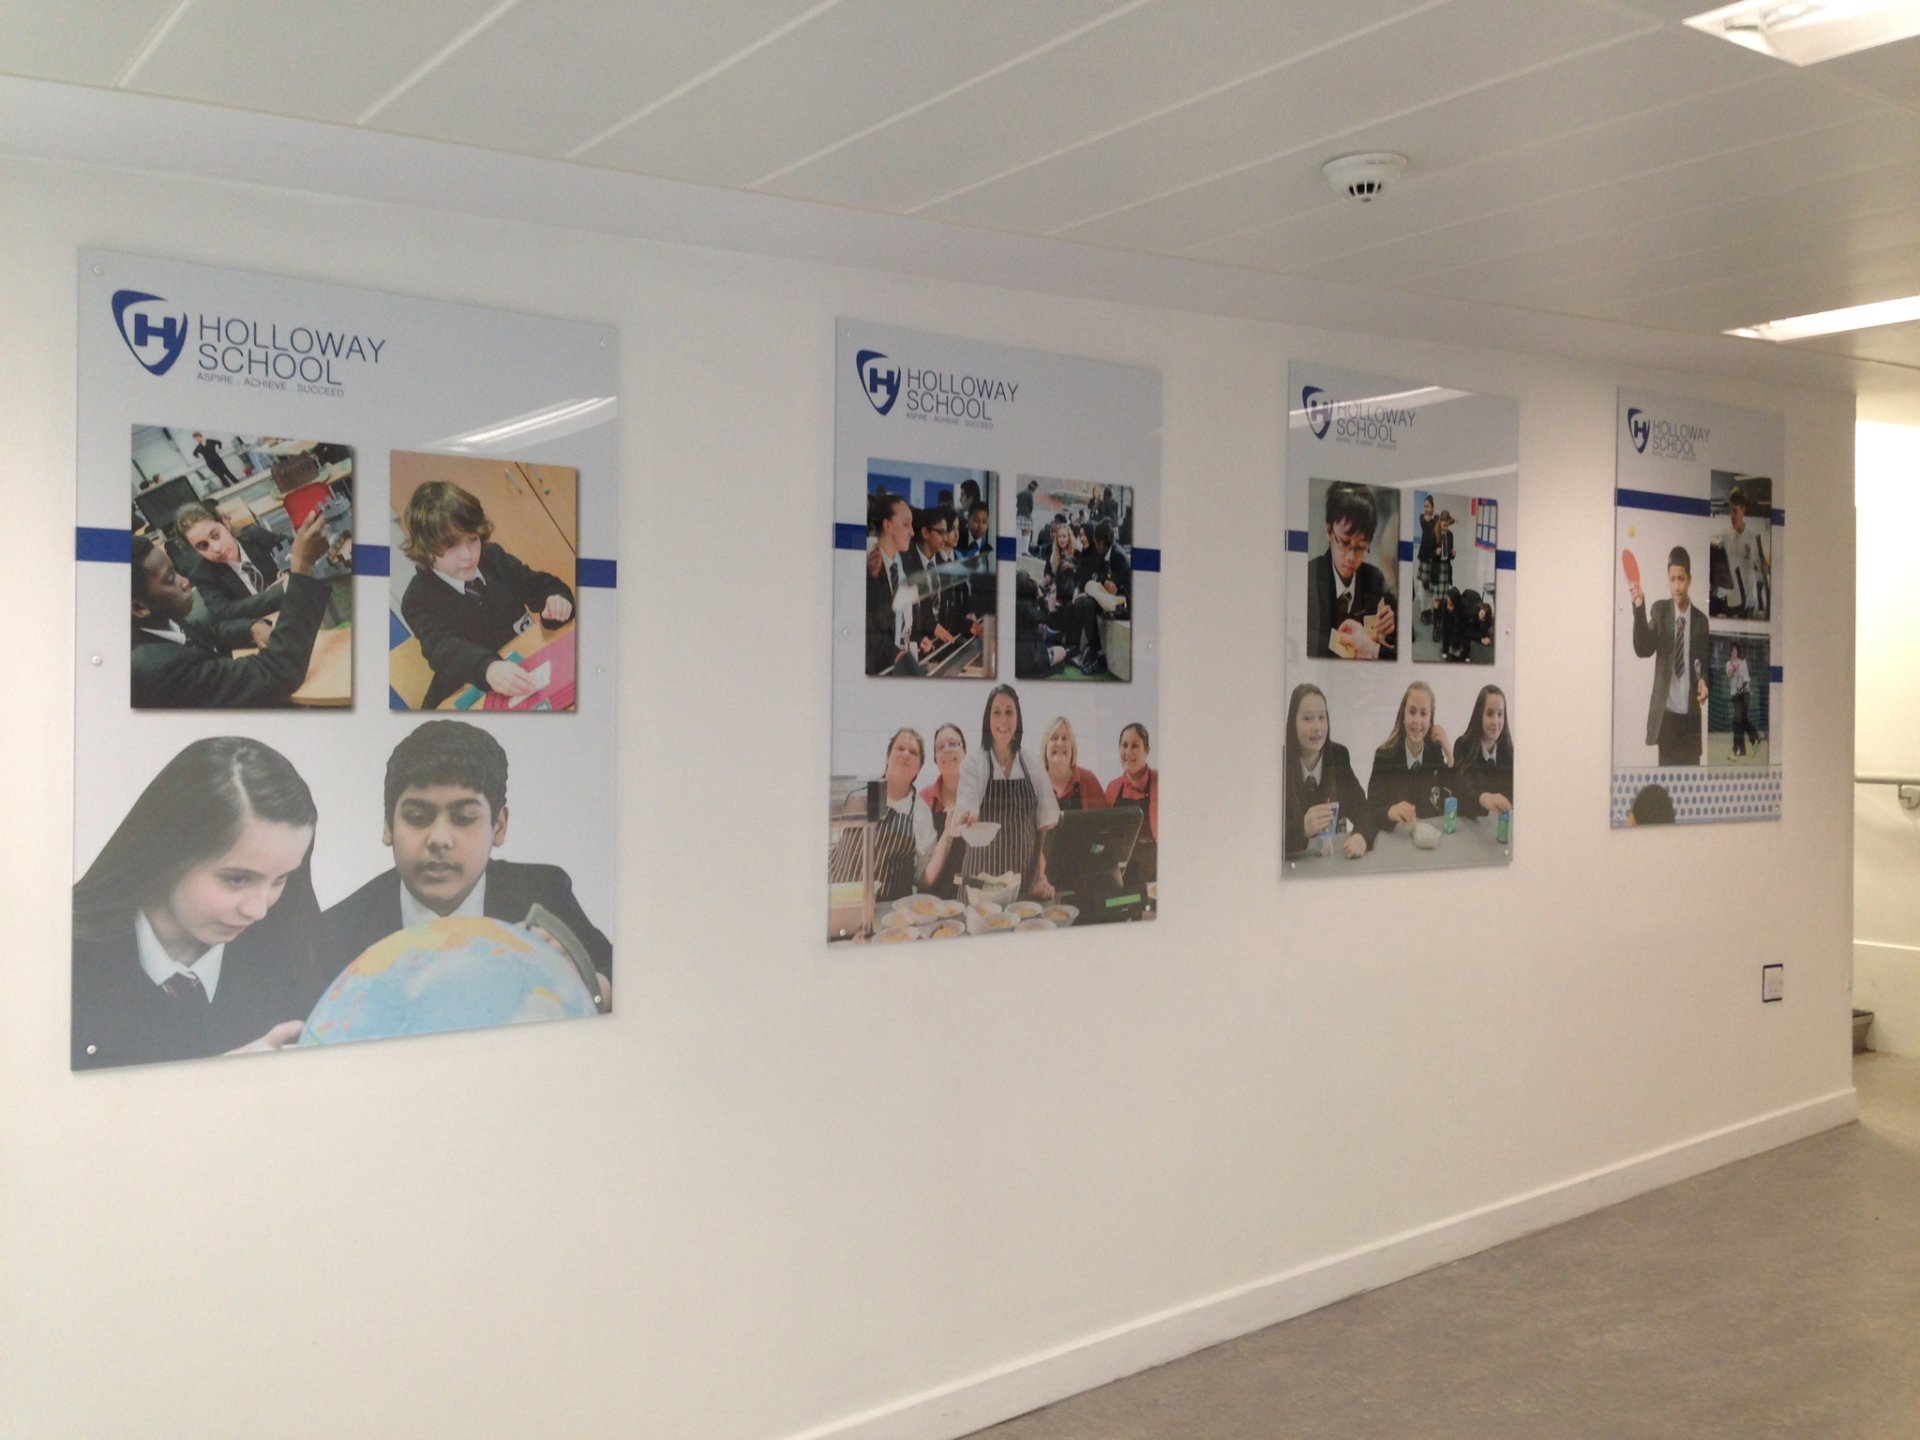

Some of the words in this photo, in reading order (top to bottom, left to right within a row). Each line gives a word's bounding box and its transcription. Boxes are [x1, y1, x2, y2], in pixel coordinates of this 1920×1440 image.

[134, 313, 177, 349] H
[200, 314, 386, 363] HOLLOWAY
[198, 343, 343, 386] SCHOOL
[197, 372, 233, 385] ASPIRE
[243, 377, 287, 391] ACHIEVE
[296, 383, 345, 397] SUCCEED
[869, 367, 895, 395] H
[907, 367, 1019, 402] HOLLOWAY
[907, 389, 992, 421] SCHOOL
[1337, 401, 1416, 428] HOLLOWAY
[1336, 417, 1397, 443] SCHOOL
[1652, 419, 1711, 443] HOLLOWAY
[1652, 435, 1697, 457] SCHOOL
